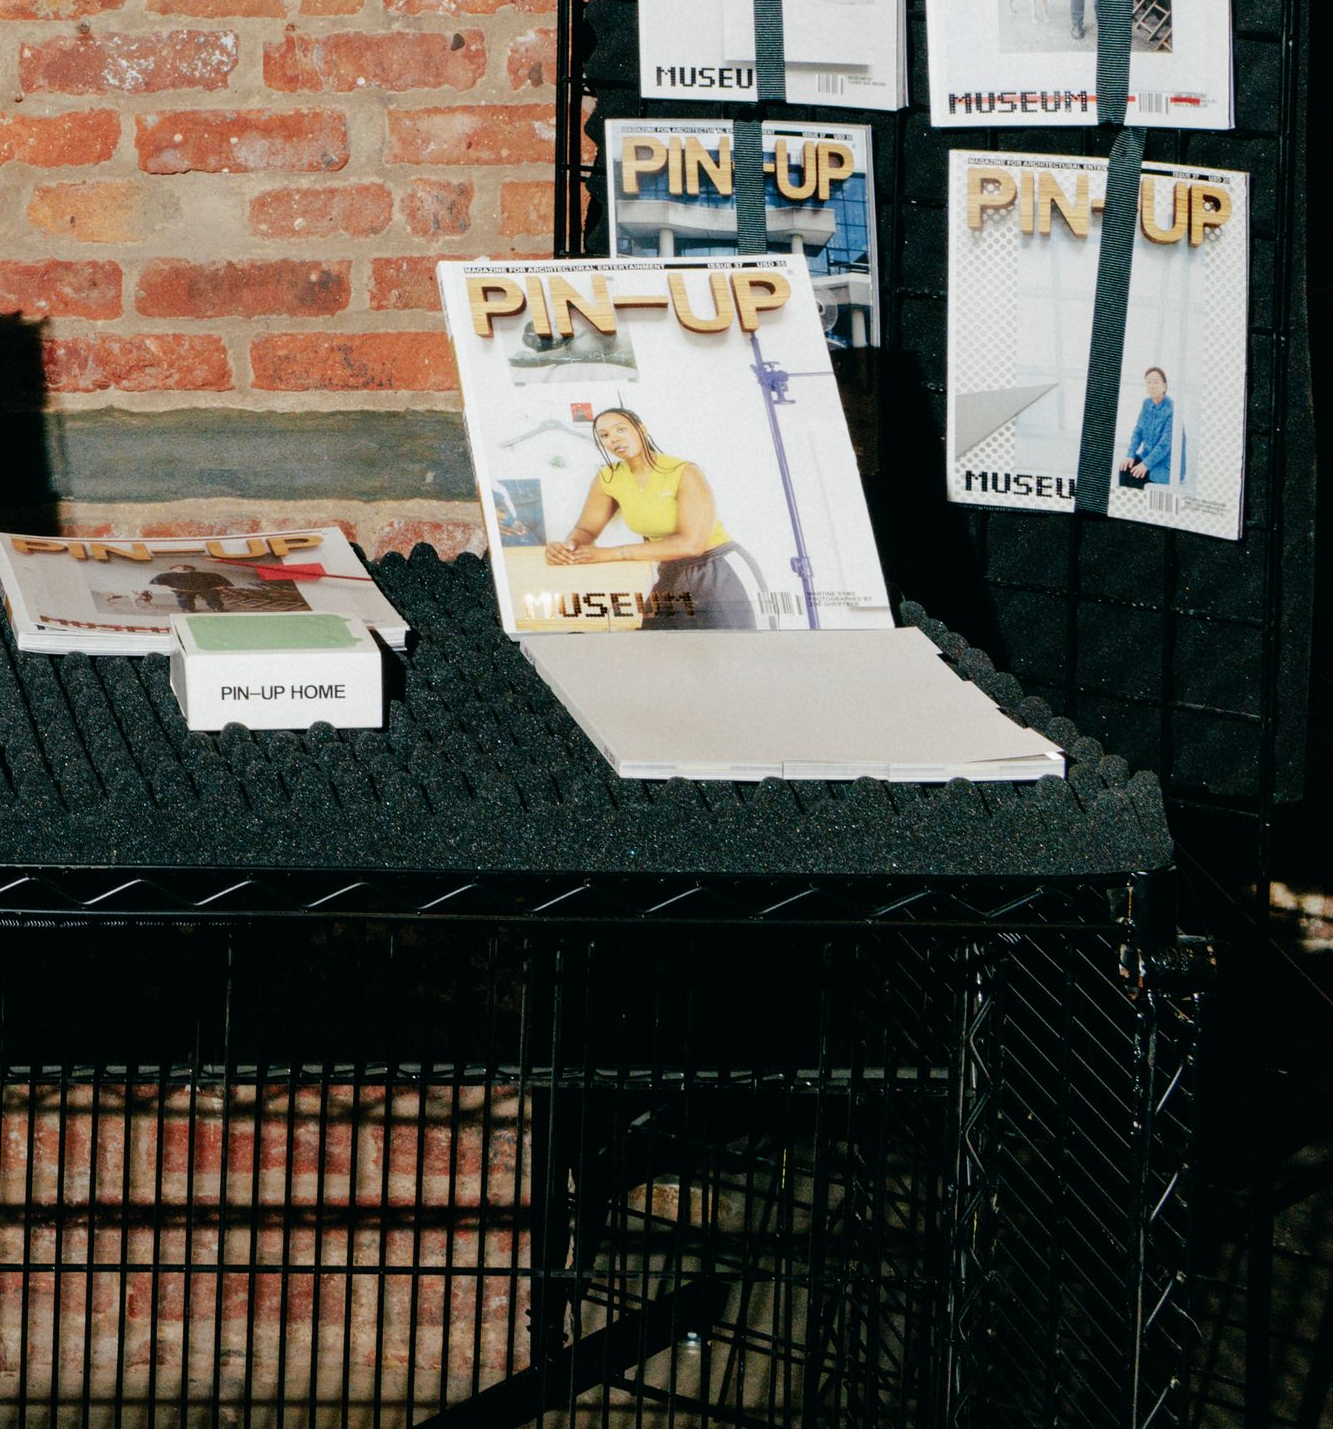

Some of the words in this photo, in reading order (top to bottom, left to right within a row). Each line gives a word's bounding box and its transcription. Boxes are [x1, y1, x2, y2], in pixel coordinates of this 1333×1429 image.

[655, 66, 753, 89] MUSEU
[949, 91, 1087, 114] MUSEUM
[968, 157, 1005, 166] MAGAZINE
[1006, 159, 1022, 167] FOR
[1023, 160, 1082, 170] ARCHITECTURAL
[464, 266, 507, 274] MAGAZINE
[509, 266, 526, 274] FOR
[528, 264, 596, 273] ARCHITECTURAL
[598, 263, 665, 271] ENTERTAINMENT
[965, 470, 1076, 499] MUSEU
[525, 591, 694, 619] MUSEUM
[291, 684, 346, 699] HOME
